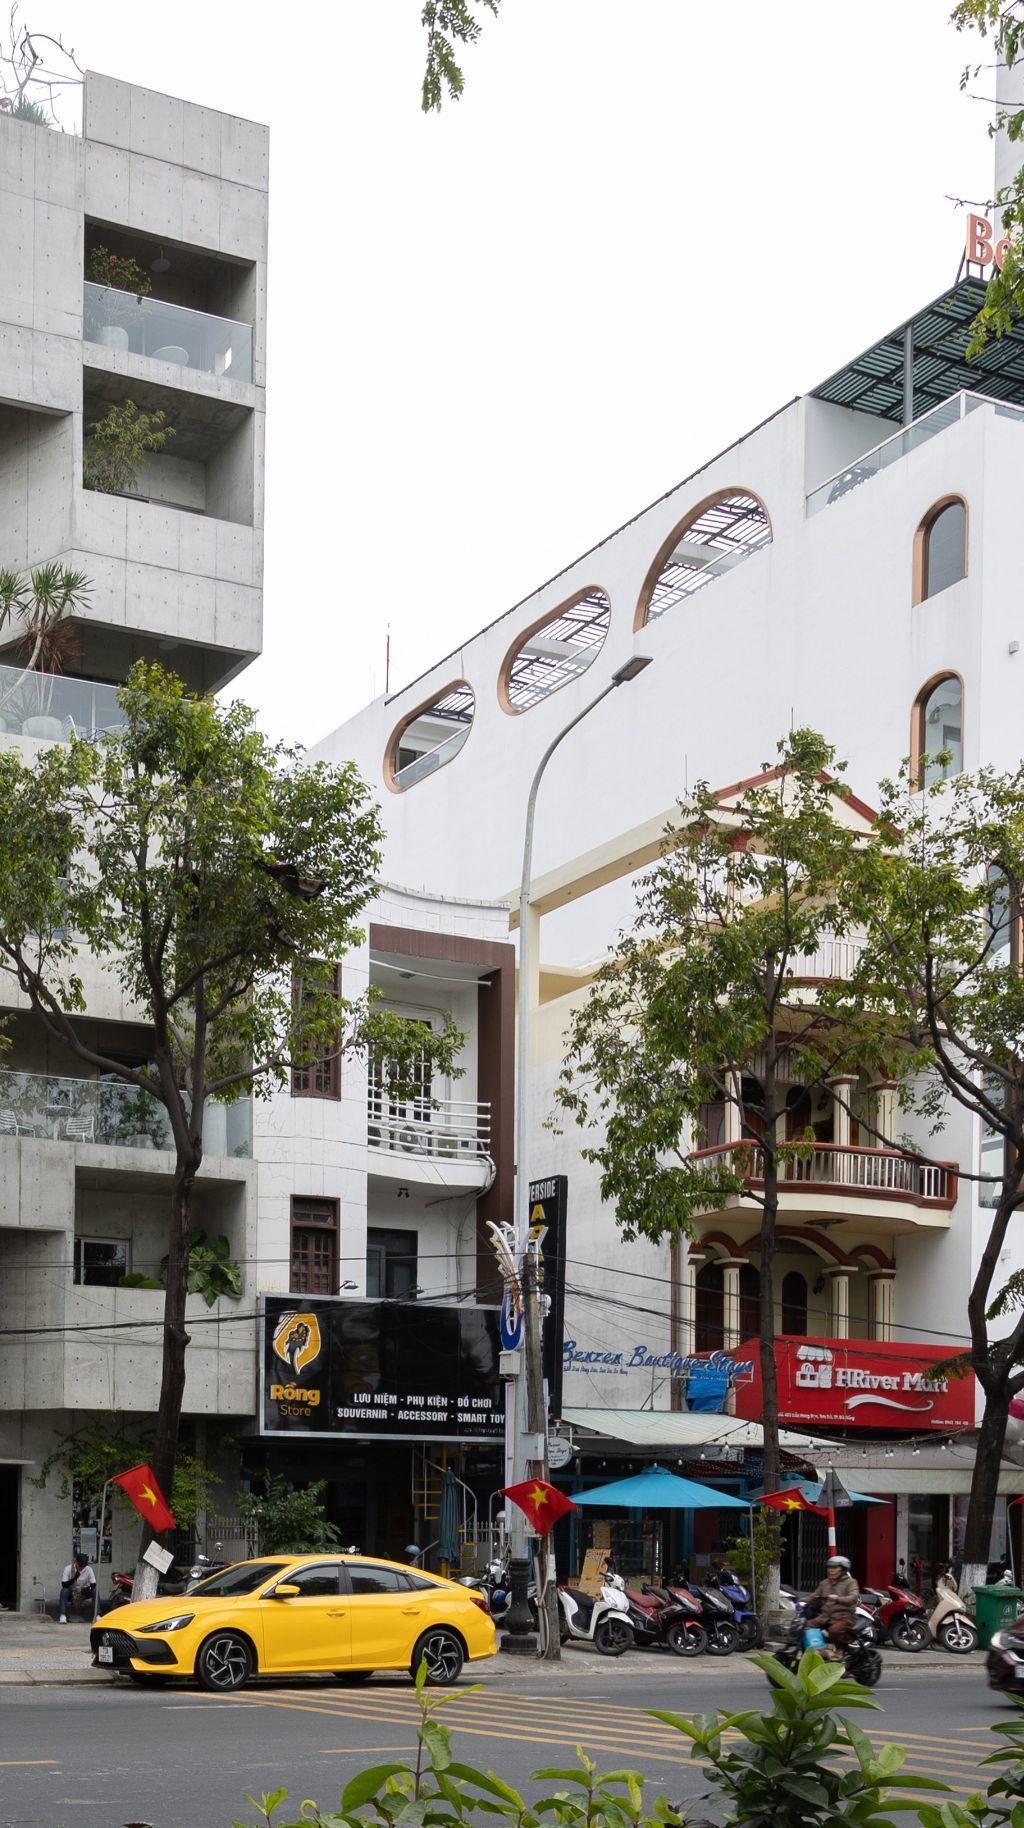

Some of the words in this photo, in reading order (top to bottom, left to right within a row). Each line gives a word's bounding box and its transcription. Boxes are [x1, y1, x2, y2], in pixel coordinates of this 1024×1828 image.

[563, 1340, 622, 1364] Benzen
[628, 1346, 704, 1378] Boutique
[835, 1368, 901, 1390] HRiver
[902, 1372, 949, 1393] Mart
[270, 1382, 321, 1406] Rồng
[354, 1393, 371, 1403] LƯU
[374, 1393, 398, 1406] NIỆM
[406, 1396, 424, 1408] PHỤ
[428, 1394, 448, 1408] KIỆN
[472, 1398, 492, 1409] CHƠI
[280, 1404, 312, 1417] Store
[338, 1408, 388, 1420] SOUVERNIR
[398, 1410, 448, 1422] ACCESSORY
[458, 1412, 486, 1424] SMART
